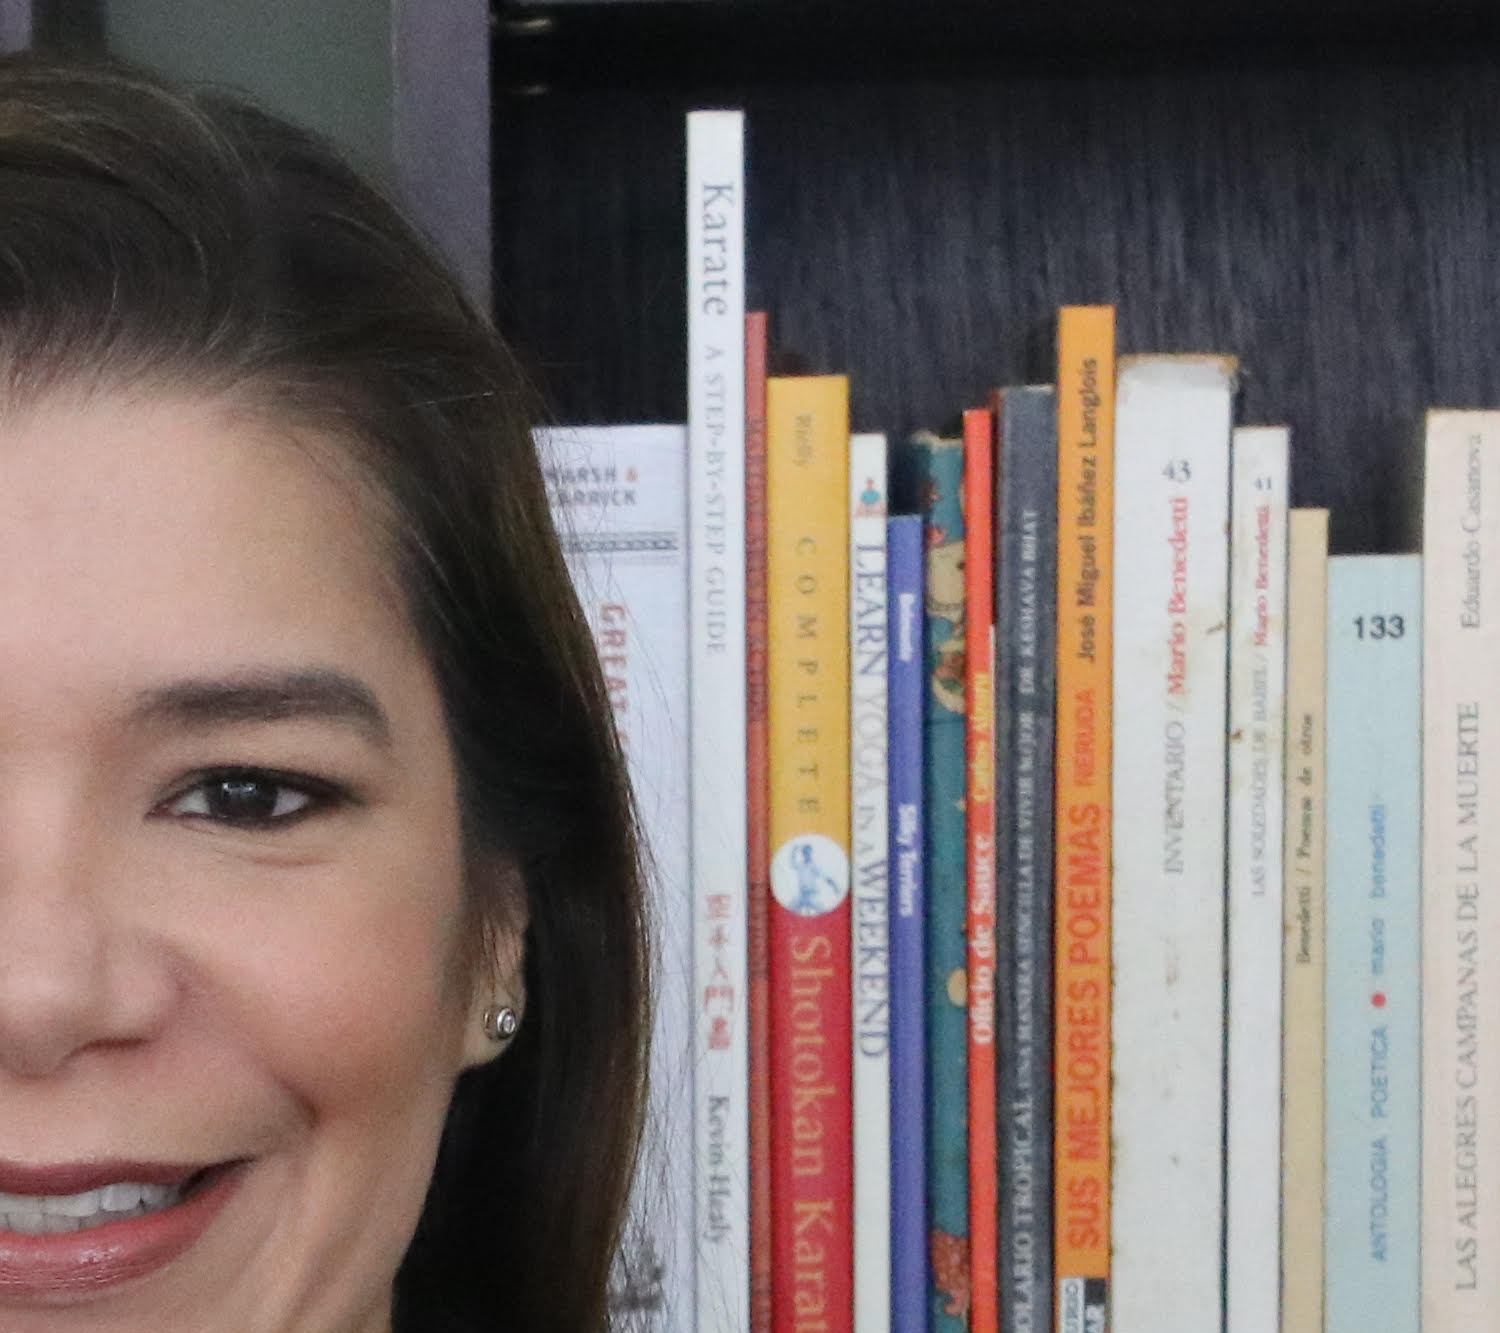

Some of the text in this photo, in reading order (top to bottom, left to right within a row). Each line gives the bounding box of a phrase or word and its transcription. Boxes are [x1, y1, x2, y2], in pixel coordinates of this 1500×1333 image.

[700, 182, 736, 655] Karate A STEP-BY-STEP GUIDE
[1074, 357, 1100, 663] José Miguel Ibáñez Langlois
[1161, 460, 1192, 484] 43
[856, 542, 887, 677] LEARN
[1352, 615, 1405, 640] 133
[1460, 432, 1483, 629] Eduardo Casanova
[796, 536, 820, 814] COMPLETE
[856, 690, 884, 798] YOGA
[1164, 496, 1189, 874] INVENTARIO Mario Benedetti
[857, 859, 888, 1060] WEEKEND
[896, 803, 919, 916] Silky Terriers
[788, 935, 835, 1177] Shotokan
[1066, 803, 1101, 1249] SUS MEJORES POEMAS
[1368, 804, 1388, 1262] ANTOLOGIA POETICA mario benedetti
[1456, 702, 1479, 1290] LAS ALEGRES CAMPANAS DE LA MUERTE
[704, 1094, 733, 1247] Kevin Healy
